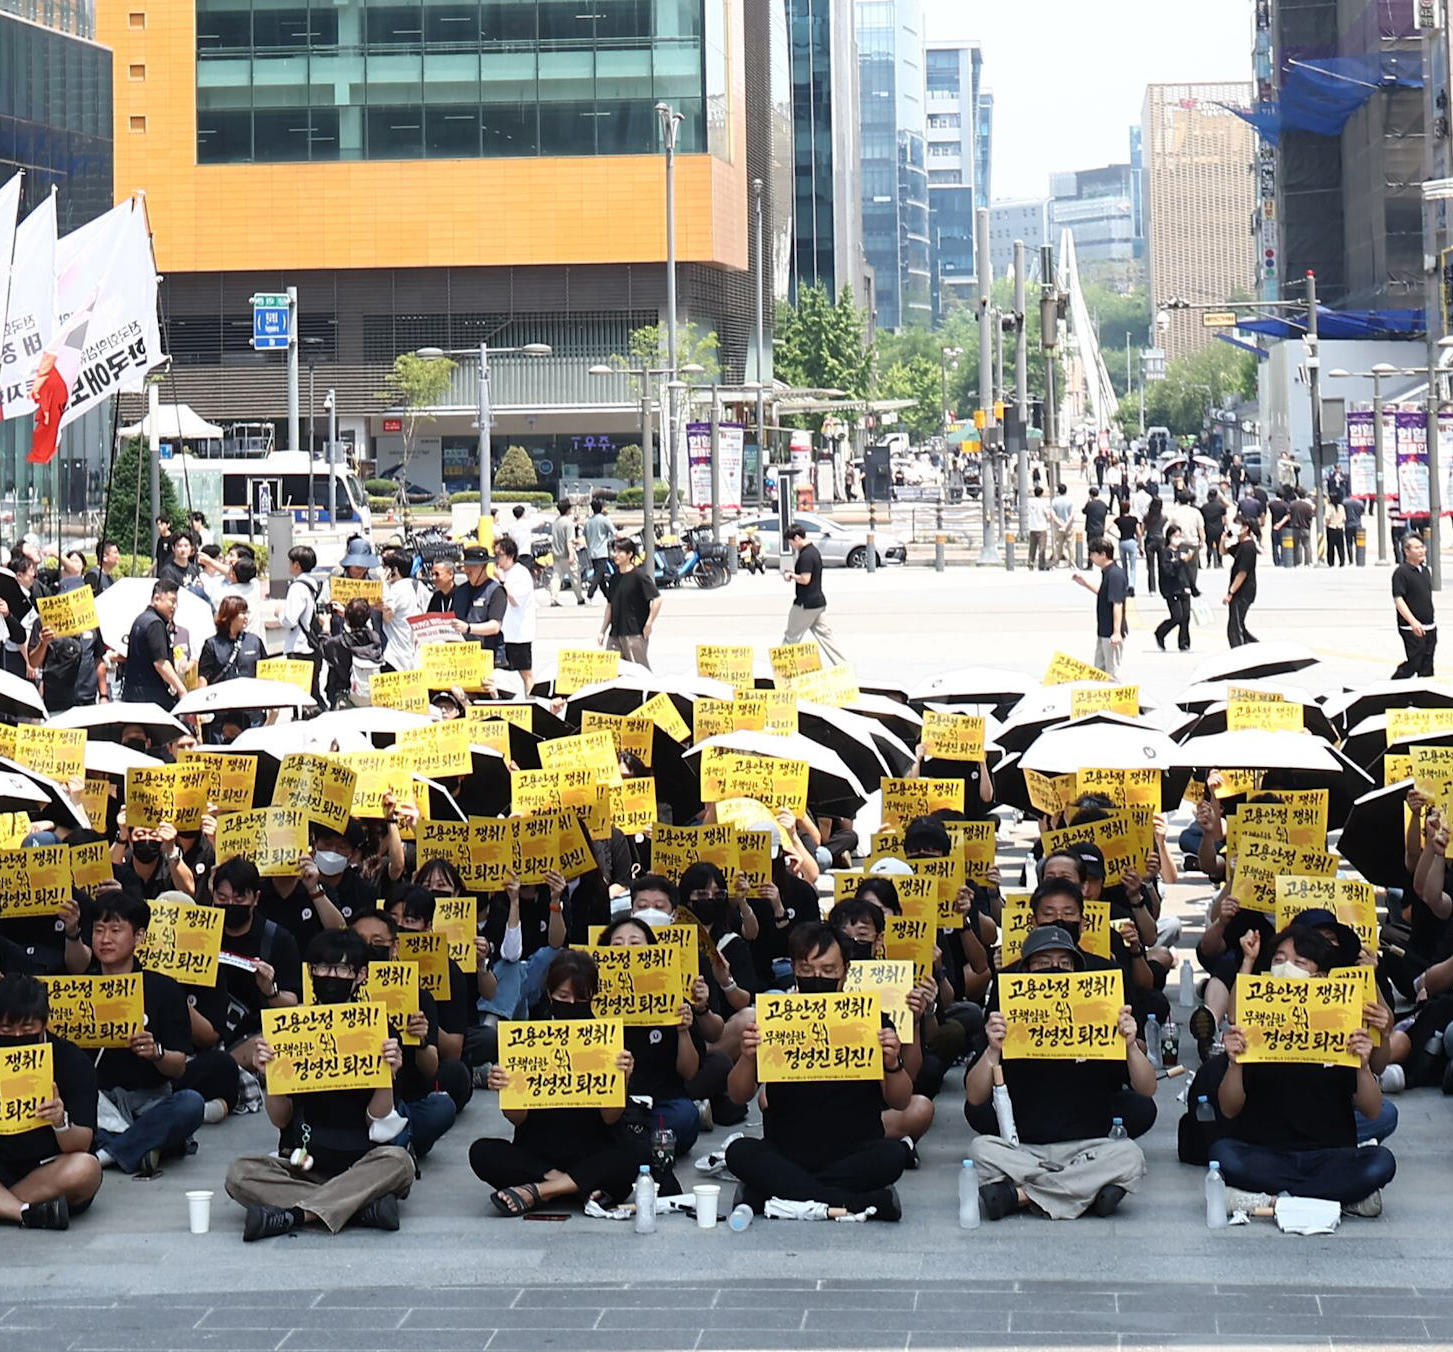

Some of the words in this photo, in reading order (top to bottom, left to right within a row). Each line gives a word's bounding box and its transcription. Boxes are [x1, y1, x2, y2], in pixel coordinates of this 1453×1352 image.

[19, 728, 55, 742] 고용안정
[27, 757, 54, 773] 경영진
[1008, 977, 1069, 1000] 고용안정
[1077, 976, 1115, 997] 쟁취!
[271, 1008, 333, 1034] 고용안정
[340, 1006, 378, 1028] 쟁취!
[1008, 1008, 1049, 1023] 무책임한
[507, 1024, 569, 1047] 고용안정
[576, 1024, 615, 1045] 쟁취!
[1027, 1024, 1074, 1047] 경영진
[1077, 1024, 1118, 1046] 퇴진!
[272, 1041, 313, 1058] 무책임한
[292, 1056, 339, 1080] 경영진
[342, 1054, 382, 1076] 퇴진!
[506, 1056, 548, 1072] 무책임한
[525, 1072, 572, 1096] 경영진
[575, 1072, 616, 1095] 퇴진!
